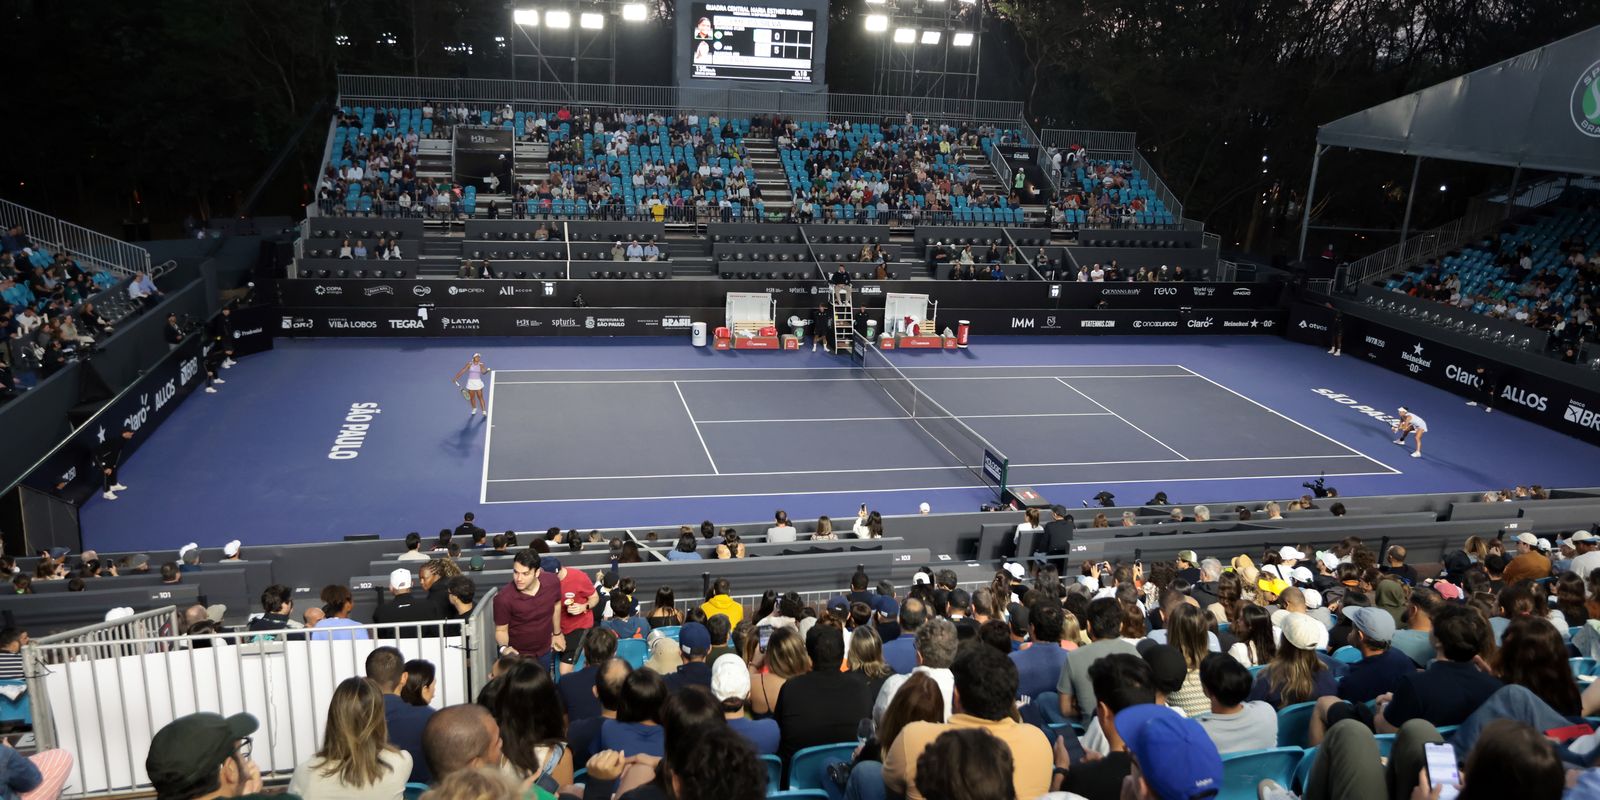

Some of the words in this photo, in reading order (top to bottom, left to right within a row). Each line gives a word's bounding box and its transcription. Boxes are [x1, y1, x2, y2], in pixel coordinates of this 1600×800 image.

[774, 32, 780, 40] 0
[389, 320, 424, 328] TEGRA
[552, 318, 576, 326] spturis
[1012, 317, 1034, 328] IMM
[1401, 352, 1431, 368] Heineken
[155, 378, 176, 411] ALLOS
[1501, 385, 1548, 411] ALLOS
[345, 402, 381, 422] SÃO
[328, 424, 370, 459] PAULO
